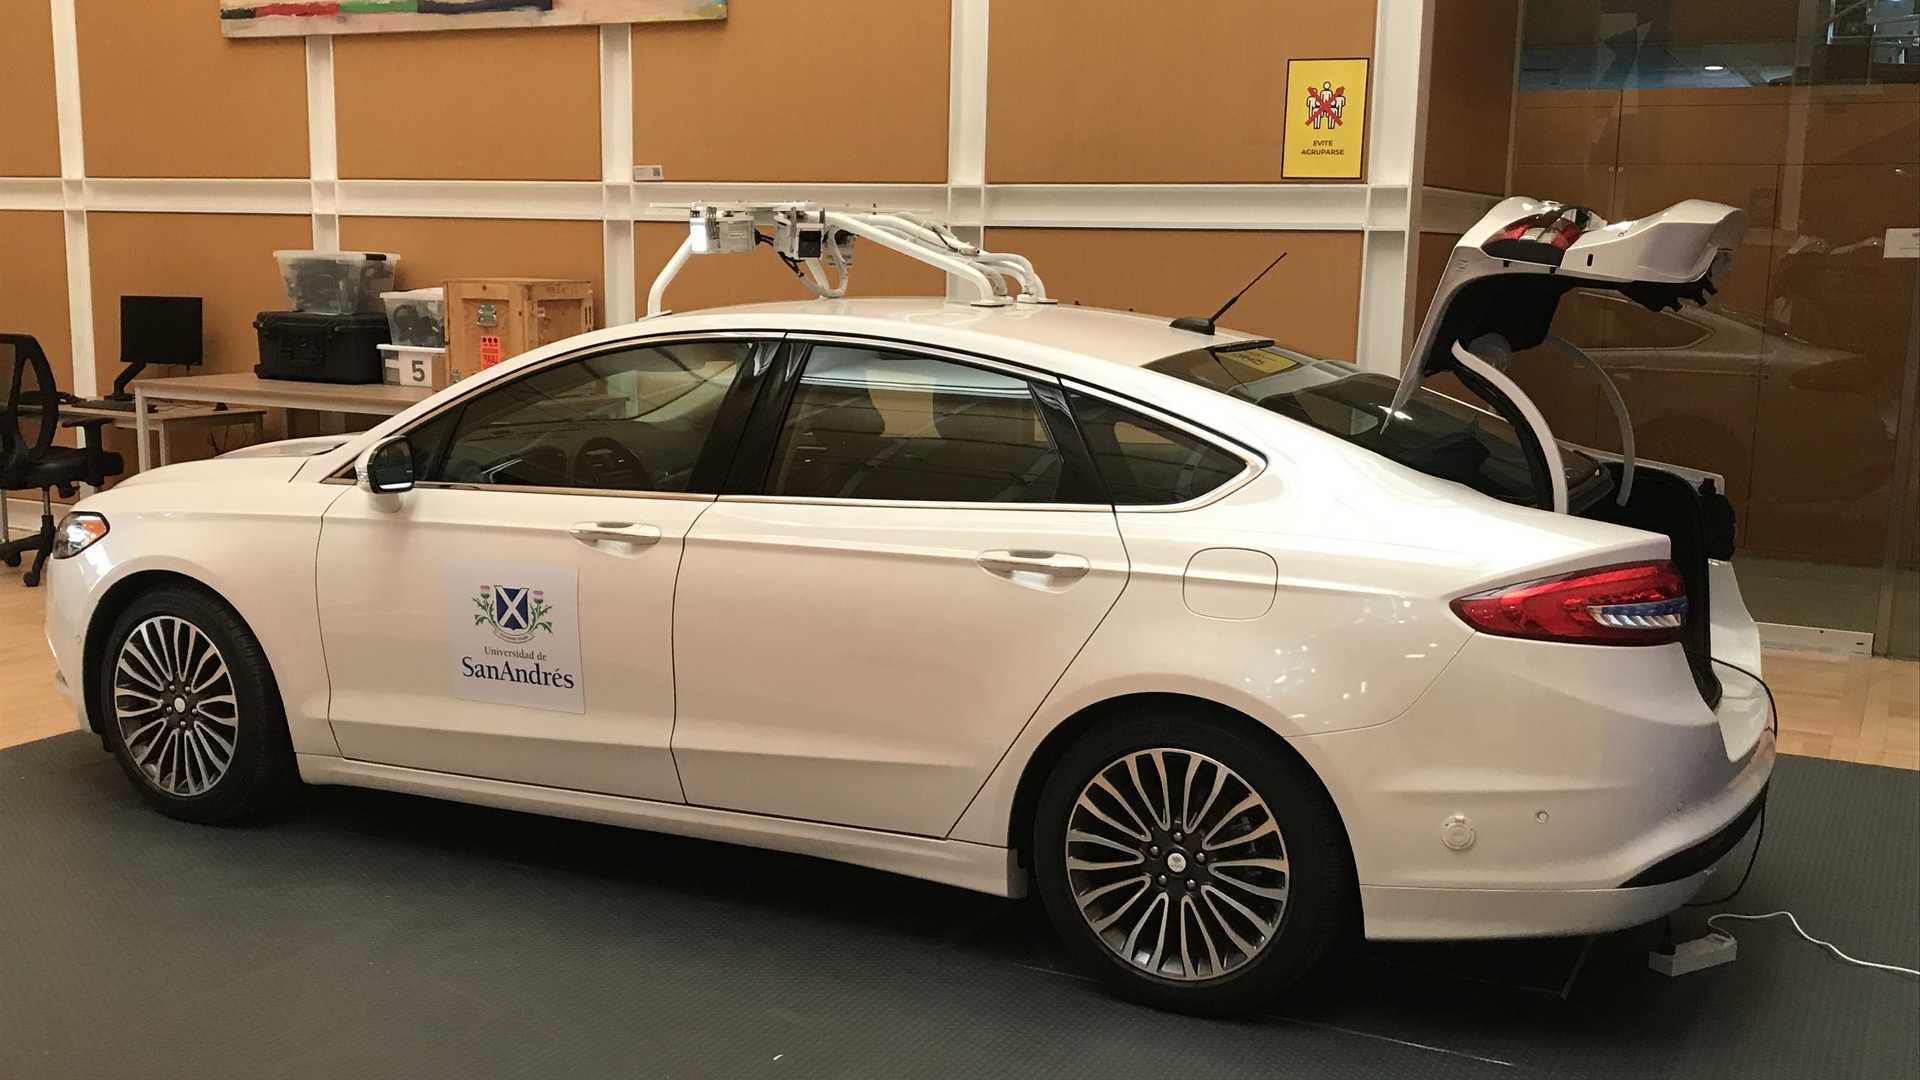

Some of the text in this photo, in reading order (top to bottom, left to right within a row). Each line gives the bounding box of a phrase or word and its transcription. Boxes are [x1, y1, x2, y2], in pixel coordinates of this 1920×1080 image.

[1312, 139, 1334, 147] EVITE
[1301, 148, 1345, 156] AGRUPARSE
[411, 359, 425, 382] 5
[484, 645, 547, 661] Universidad de
[462, 656, 575, 689] SanAndrés
